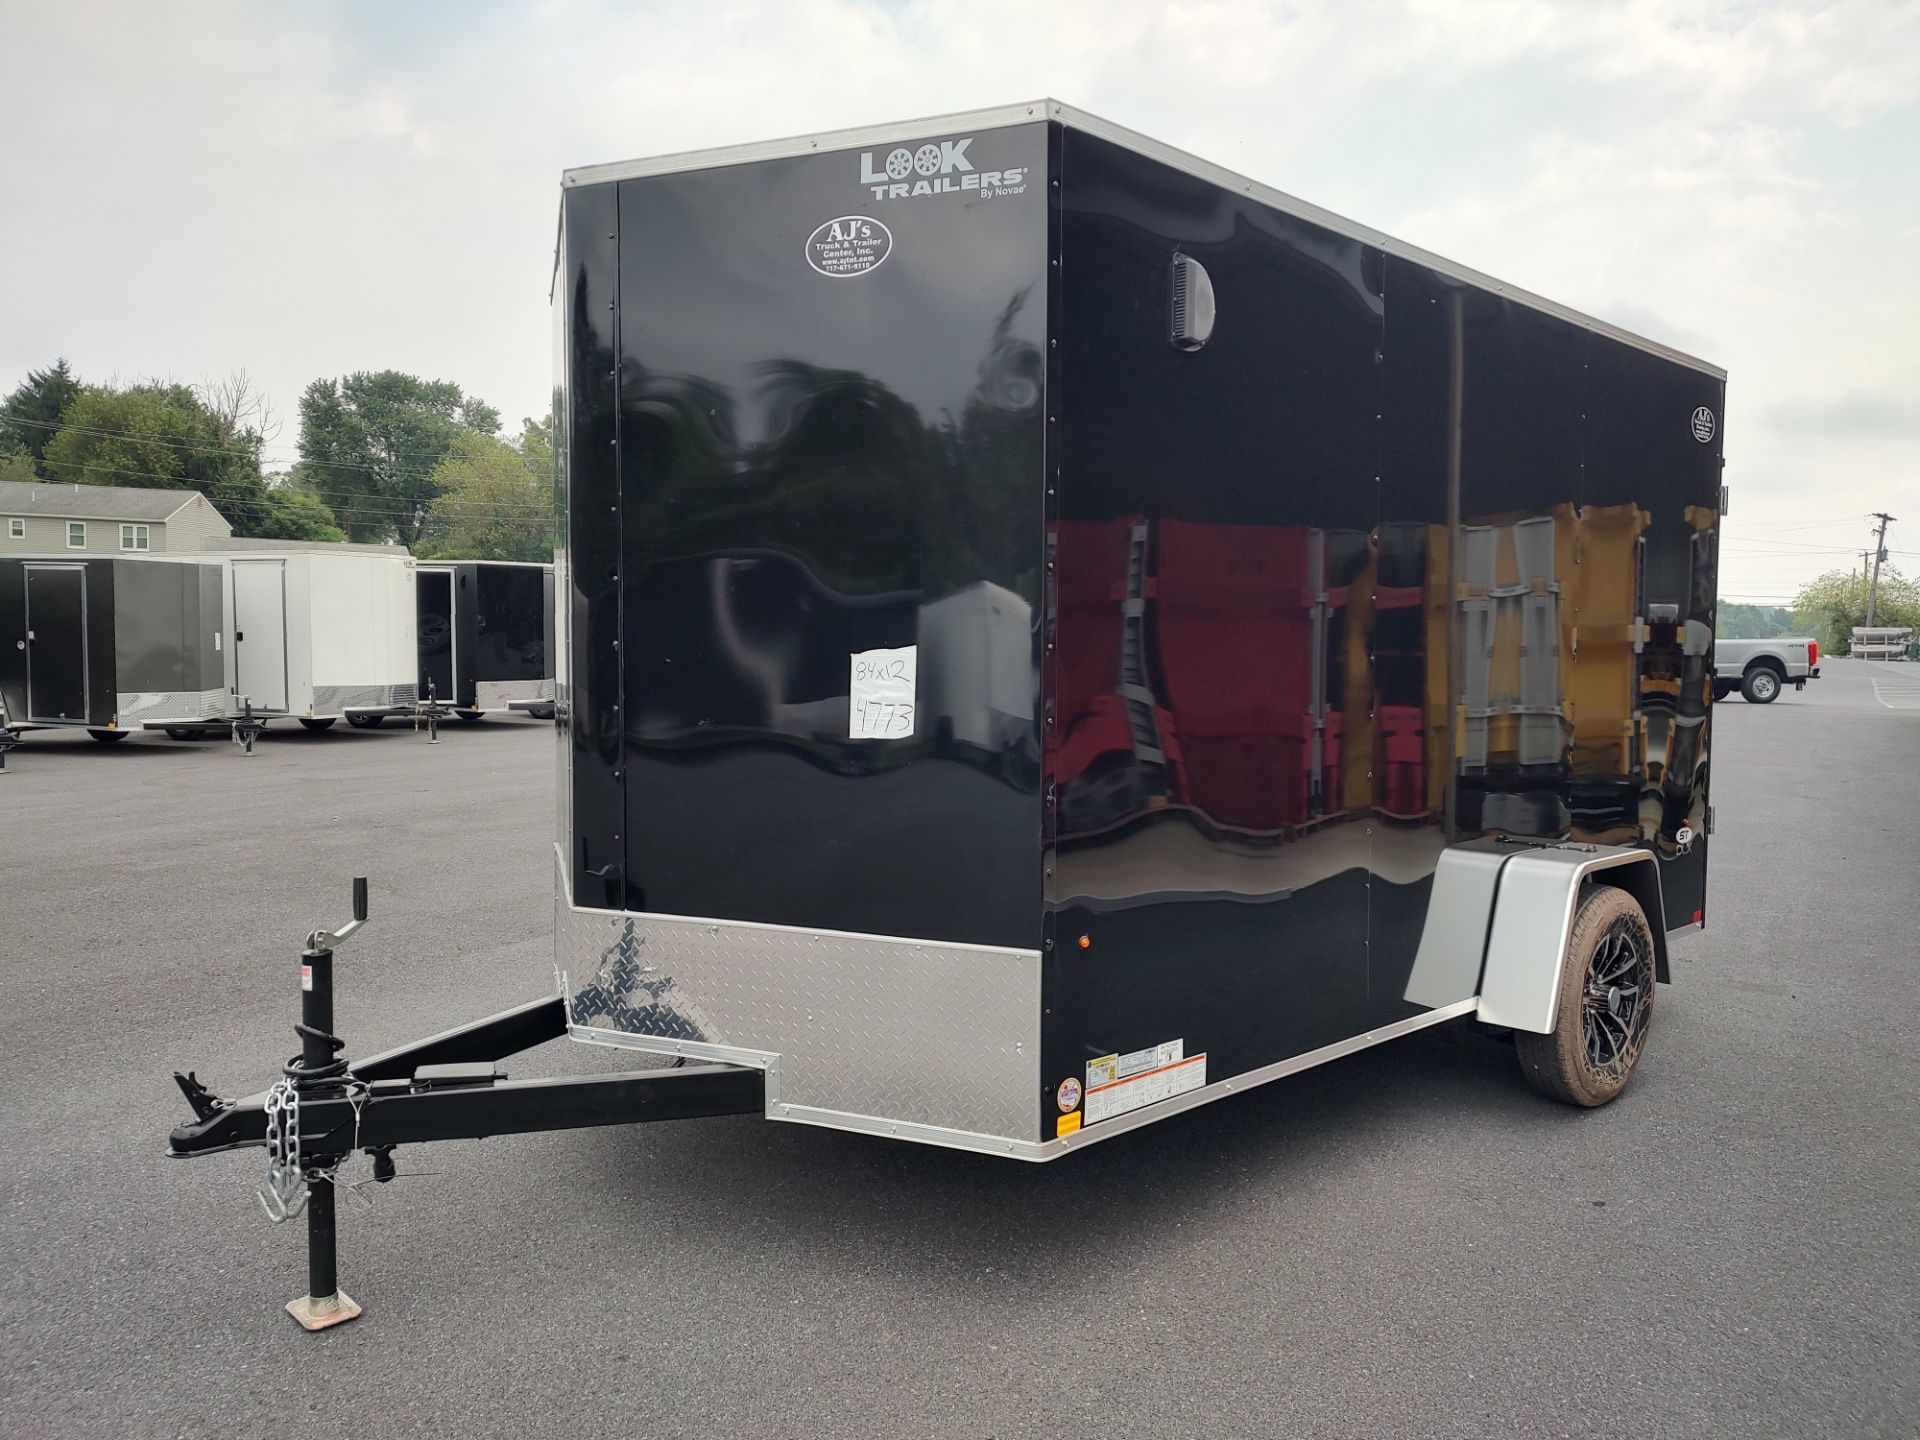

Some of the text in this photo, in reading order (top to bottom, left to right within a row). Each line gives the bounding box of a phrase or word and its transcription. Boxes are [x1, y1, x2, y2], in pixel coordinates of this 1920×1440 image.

[861, 138, 975, 184] LOOK
[981, 189, 993, 199] By
[827, 220, 871, 242] AJ's
[815, 238, 882, 250] Truck & Trailer
[823, 247, 874, 258] Center, Inc.
[857, 699, 913, 732] 4773
[1679, 830, 1690, 840] ST
